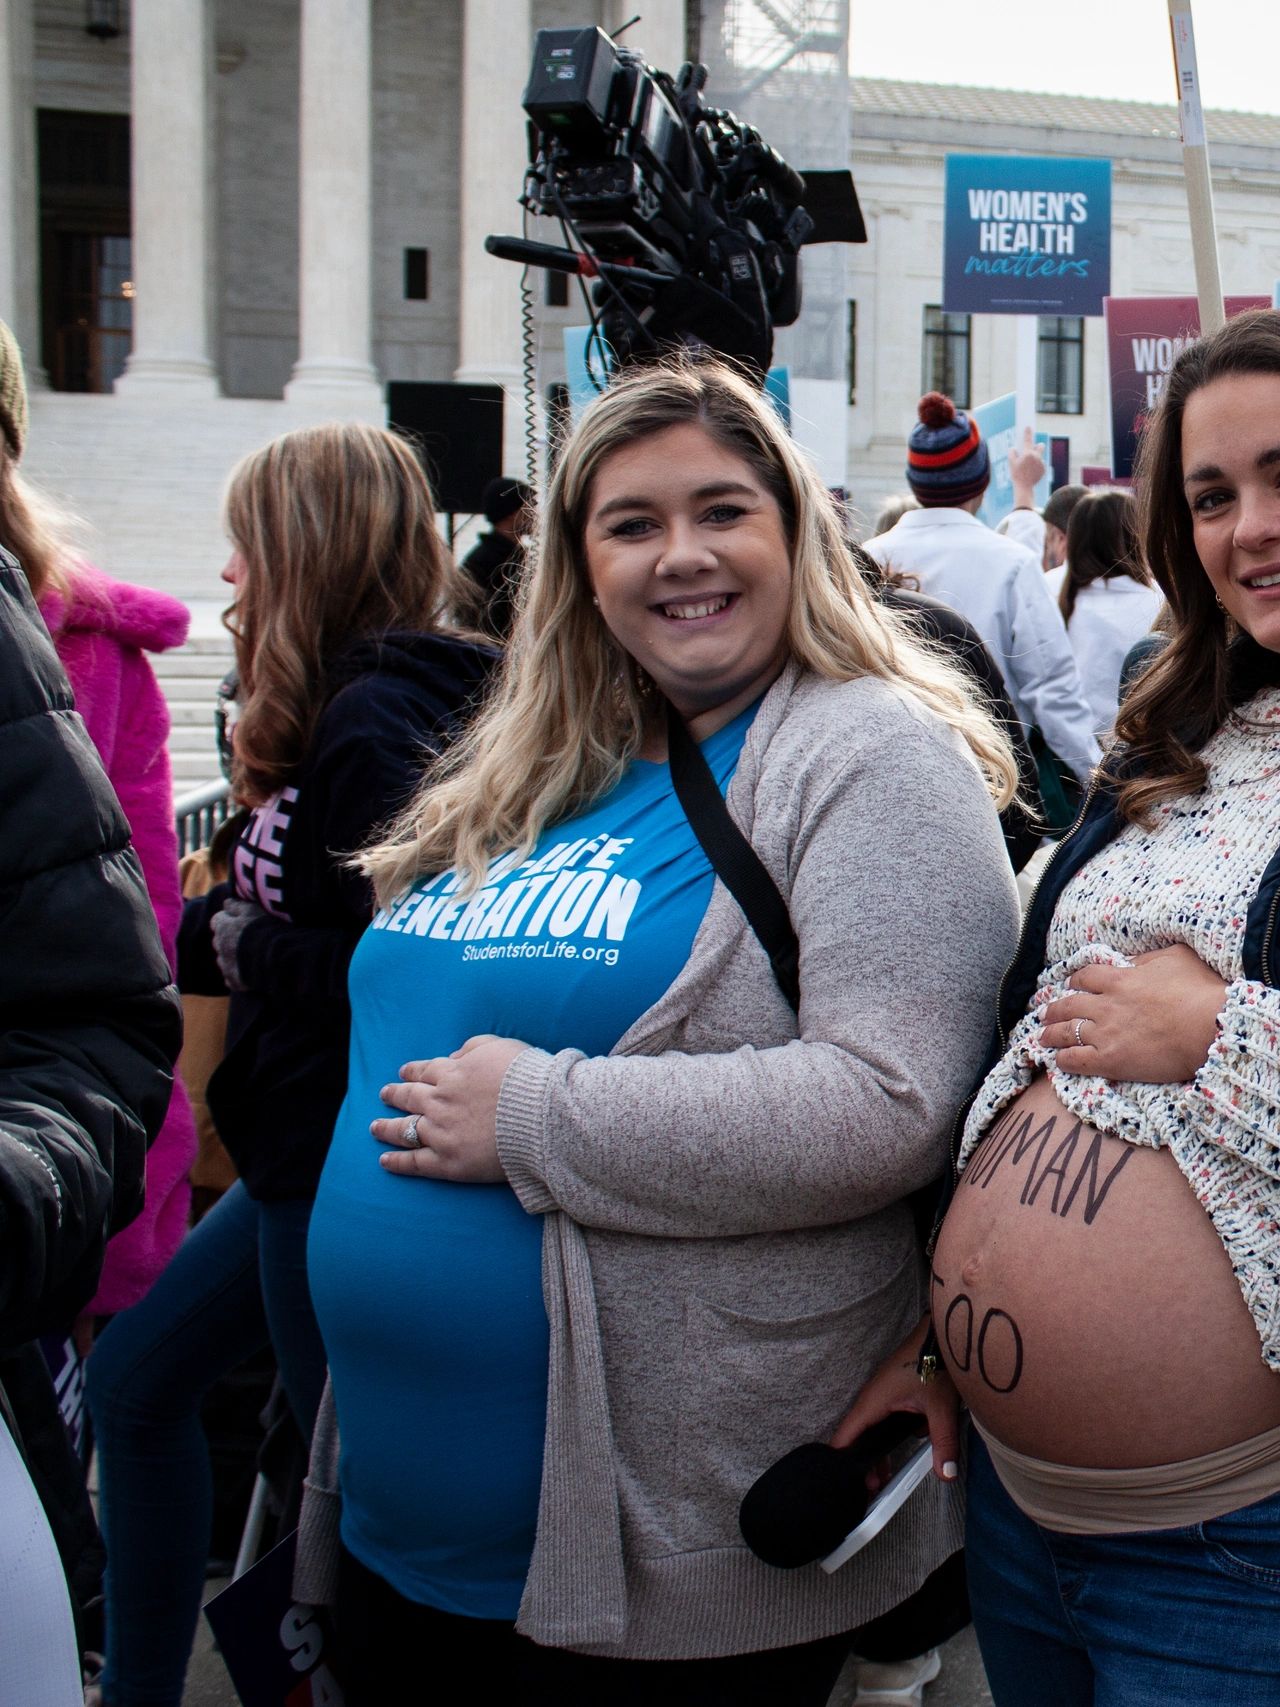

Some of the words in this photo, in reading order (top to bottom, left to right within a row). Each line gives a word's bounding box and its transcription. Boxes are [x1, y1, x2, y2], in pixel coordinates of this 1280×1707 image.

[968, 189, 1088, 223] WOMEN'S
[980, 221, 1074, 255] HEALTH
[964, 246, 1090, 278] matters
[373, 870, 642, 941] GENERATION
[462, 941, 620, 966] StudentsforLife.org
